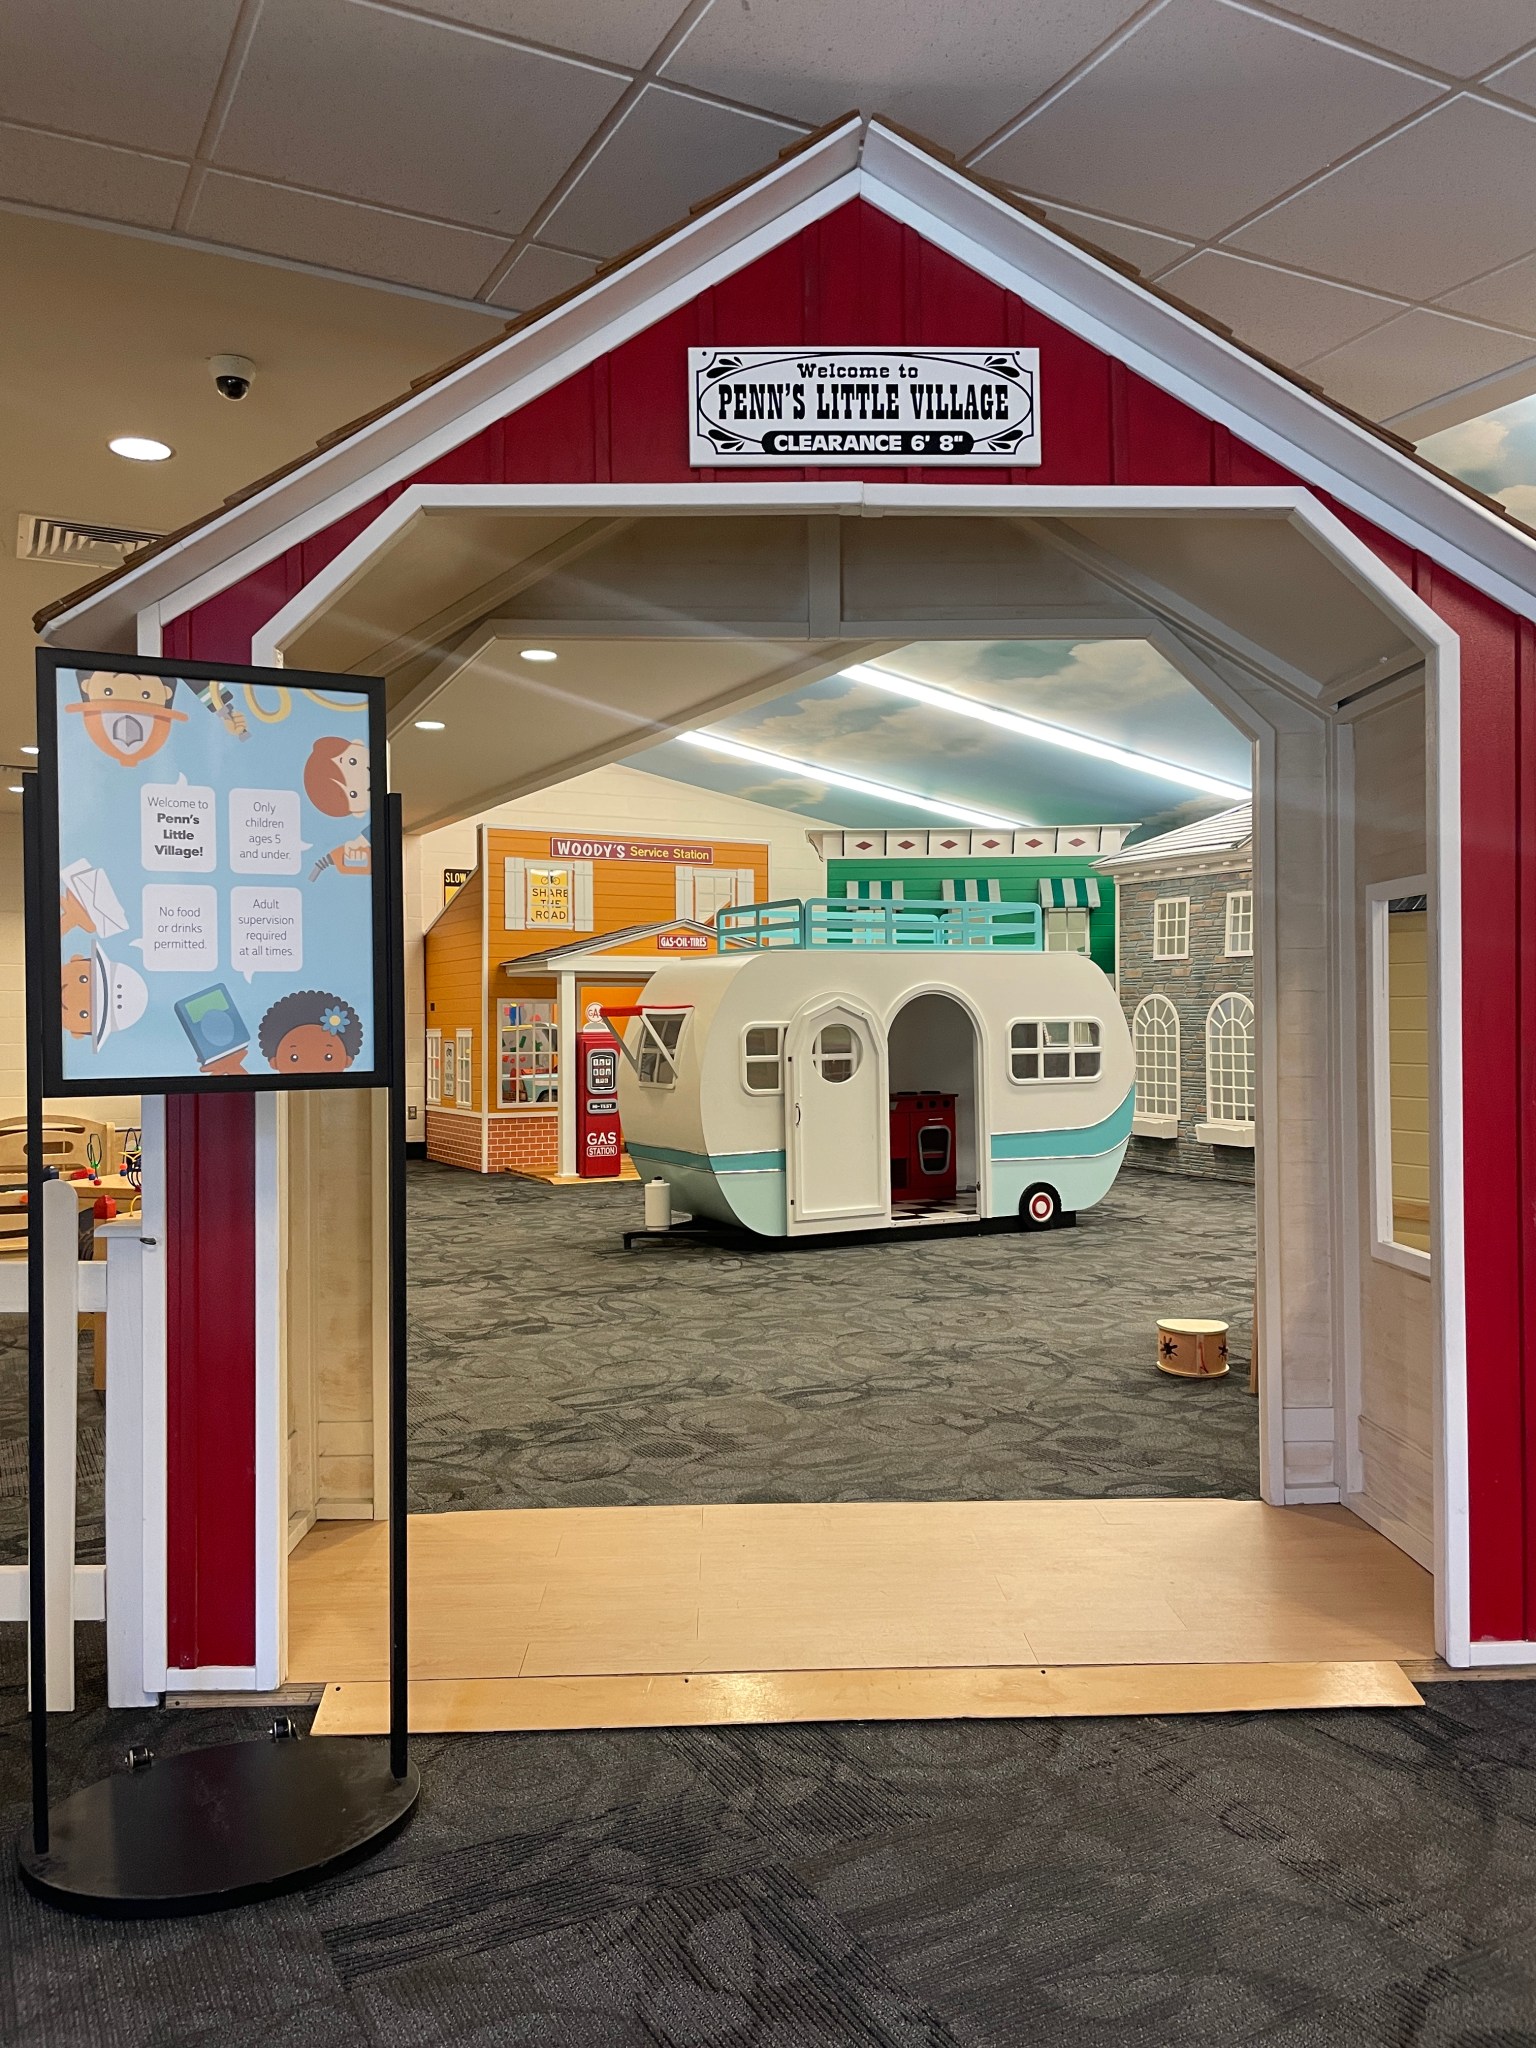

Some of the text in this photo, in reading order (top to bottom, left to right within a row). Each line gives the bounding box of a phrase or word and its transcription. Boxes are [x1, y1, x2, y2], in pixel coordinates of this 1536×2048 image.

[797, 363, 919, 379] Welcome to
[718, 383, 1009, 420] PENN'S LITTLE VILLAGE
[773, 434, 903, 452] CLEARANCE
[910, 434, 931, 452] 6'
[147, 796, 209, 810] Welcome to
[253, 801, 277, 816] Only
[156, 812, 200, 825] Penn's
[245, 817, 285, 829] children
[163, 829, 195, 841] Little
[249, 834, 281, 846] ages 5
[154, 844, 204, 859] Village!
[239, 849, 292, 860] and under.
[557, 841, 710, 860] WOODY'S Service Station
[445, 872, 468, 884] SLOW
[532, 888, 568, 898] SHARE
[252, 899, 280, 909] Adult
[159, 906, 201, 918] No food
[535, 910, 566, 920] ROAD
[238, 916, 295, 927] supervision
[157, 923, 203, 933] or drinks
[246, 930, 287, 942] required
[154, 939, 208, 951] permitted.
[239, 947, 250, 956] at
[251, 945, 263, 956] all
[587, 1008, 602, 1019] GA
[587, 1132, 616, 1145] GAS
[589, 1147, 615, 1156] STATION
